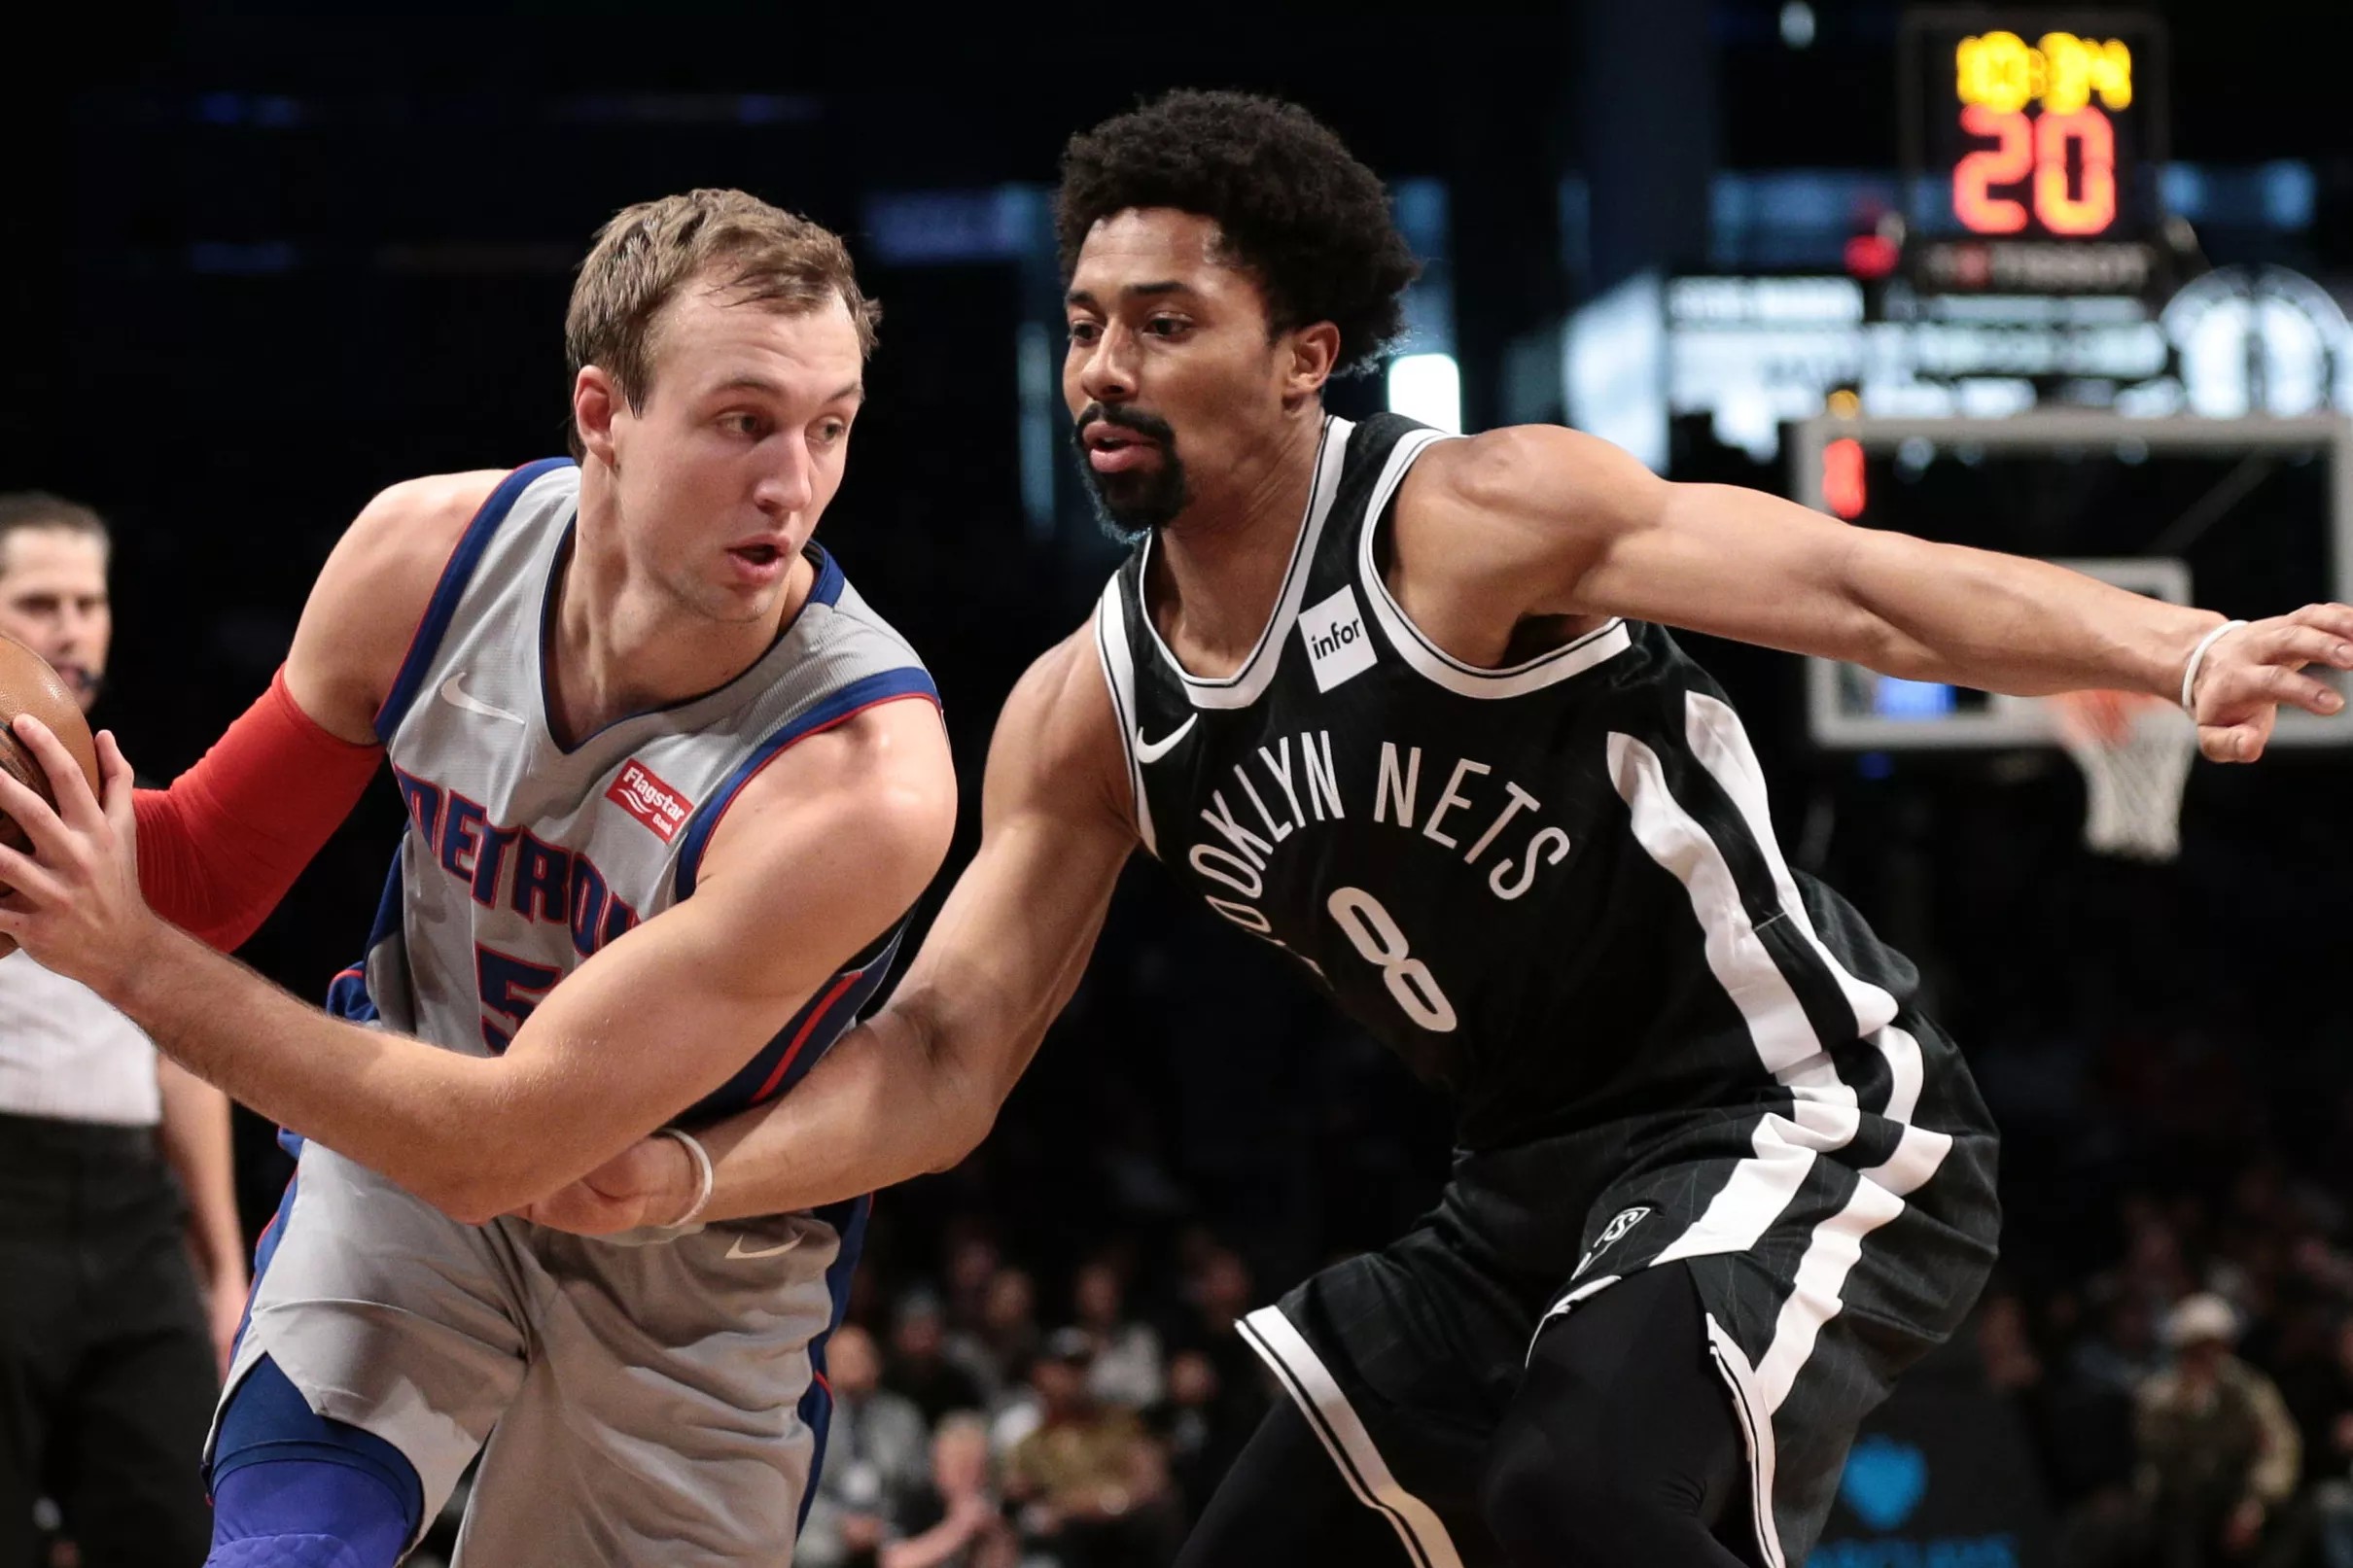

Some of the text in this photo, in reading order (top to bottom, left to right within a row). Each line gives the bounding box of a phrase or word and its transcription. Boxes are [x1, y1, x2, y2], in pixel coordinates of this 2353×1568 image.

[1952, 102, 2116, 235] 20
[1311, 618, 1360, 660] infor
[623, 766, 685, 822] Flagstar
[1189, 730, 1570, 958] OOKLYN NETS
[474, 940, 563, 1057] 5
[1327, 887, 1457, 1032] 8
